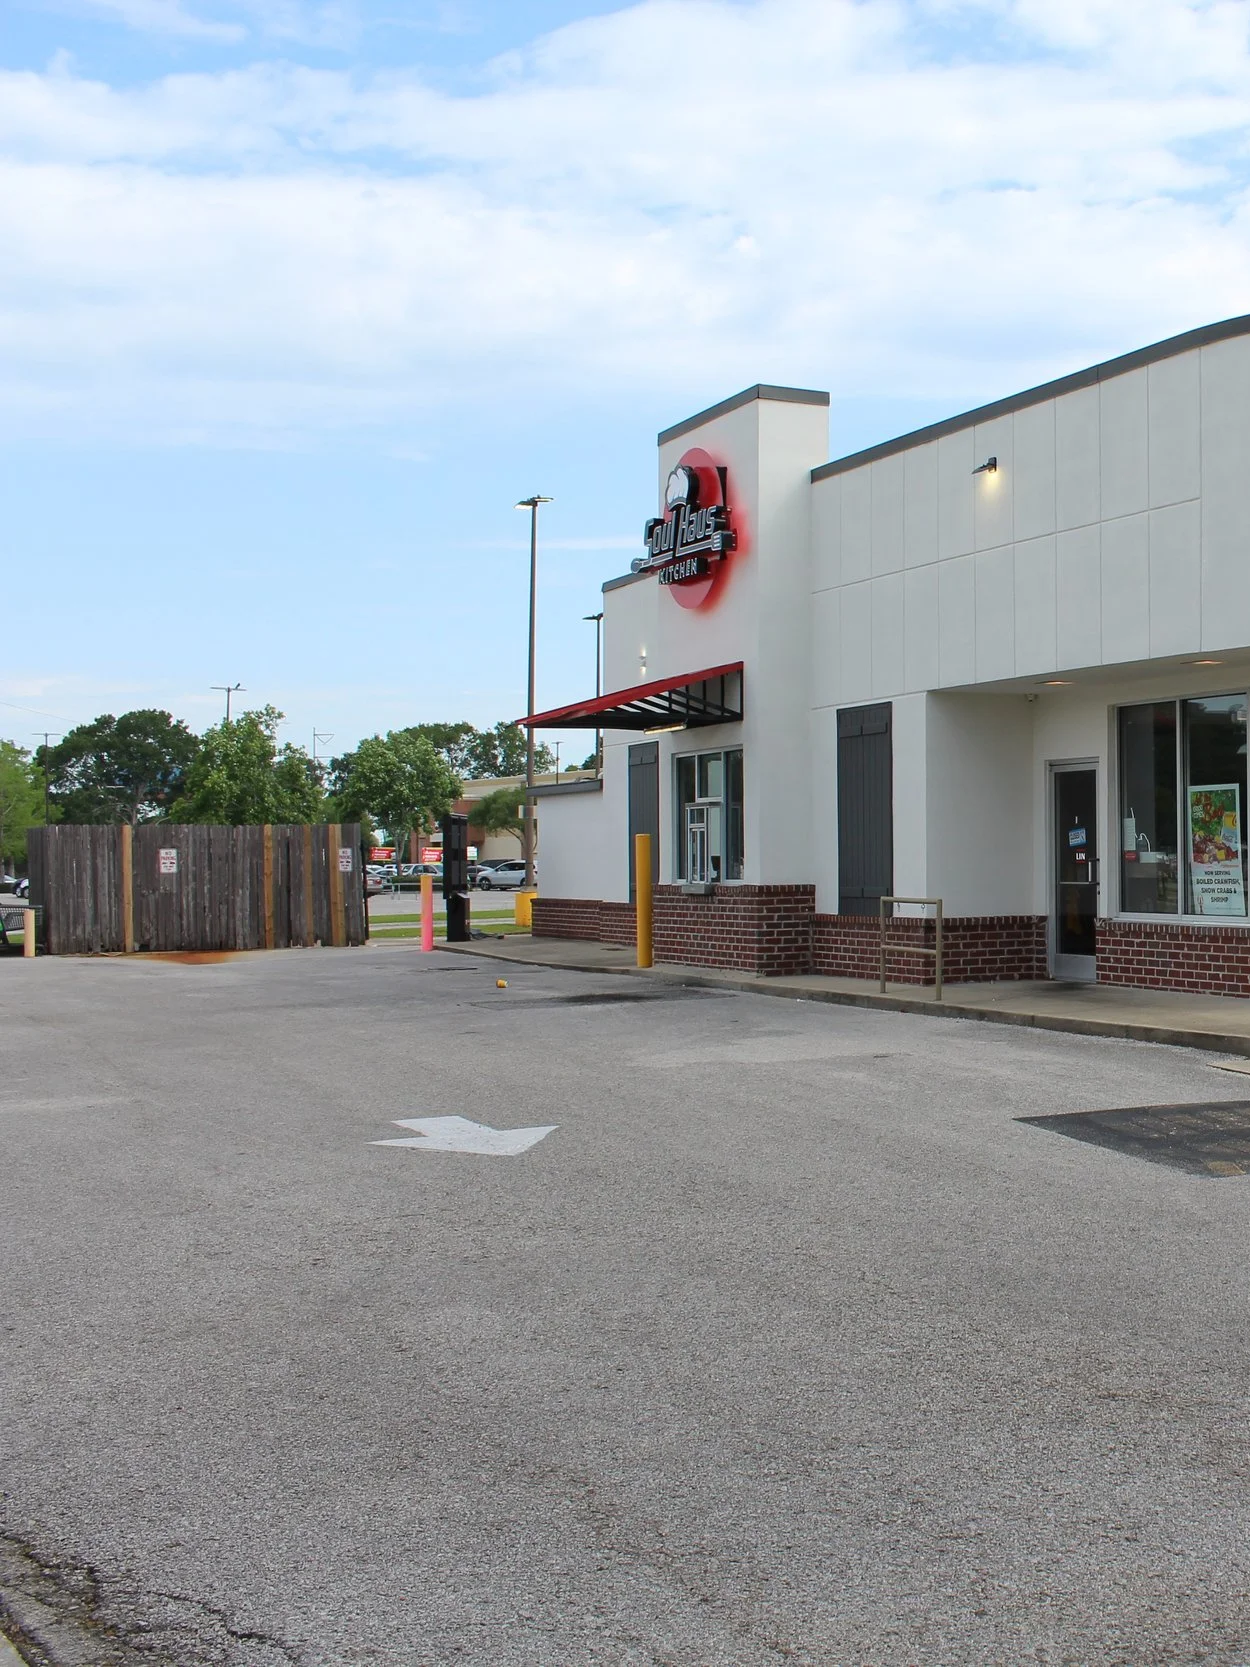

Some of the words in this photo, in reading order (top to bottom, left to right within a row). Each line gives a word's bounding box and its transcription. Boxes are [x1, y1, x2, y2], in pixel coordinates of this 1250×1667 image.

[644, 511, 676, 564] Soul
[676, 504, 717, 557] Haus
[658, 558, 699, 585] KITCHEN
